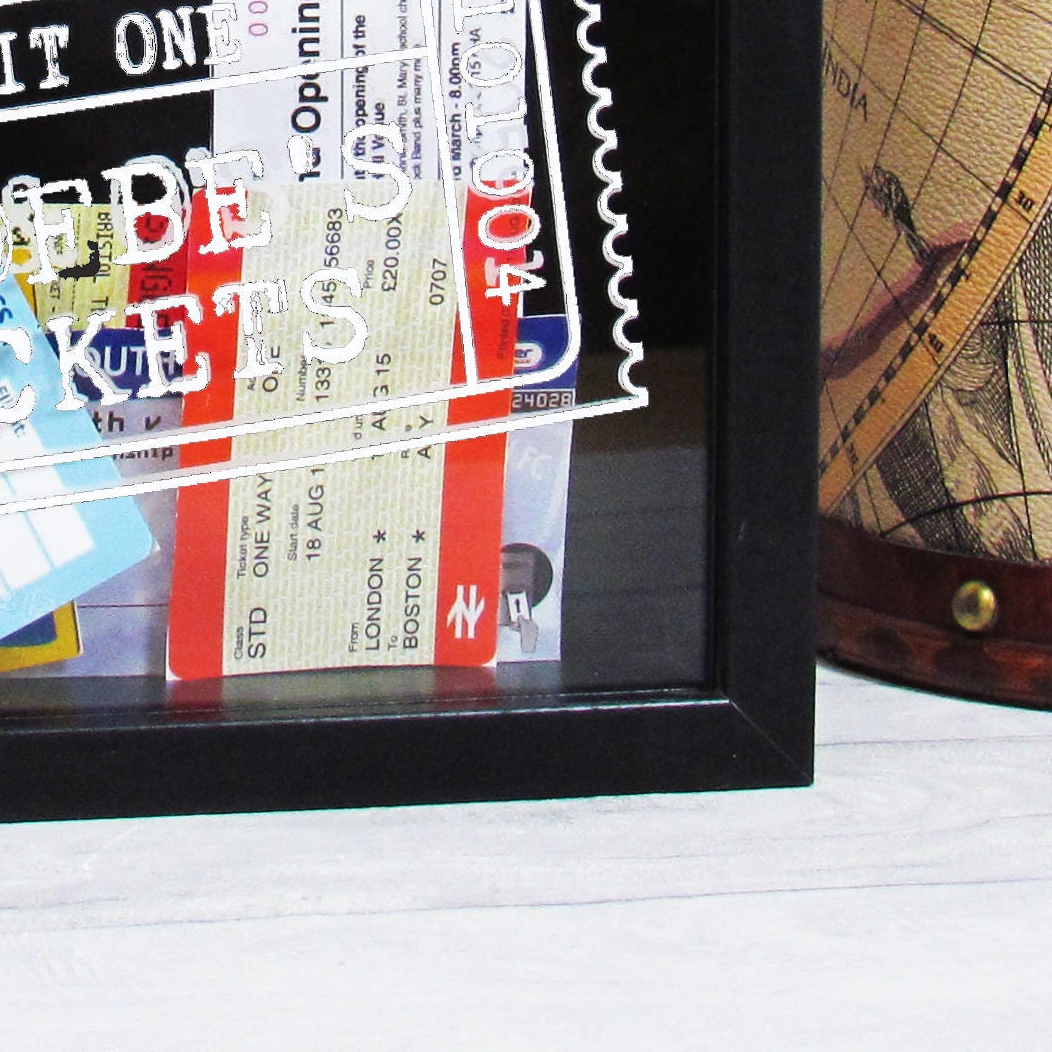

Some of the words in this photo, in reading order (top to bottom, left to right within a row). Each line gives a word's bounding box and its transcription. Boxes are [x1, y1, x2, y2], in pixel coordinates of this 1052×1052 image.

[115, 2, 242, 76] ONE
[352, 14, 366, 41] the
[363, 259, 375, 289] Price
[429, 258, 448, 306] 0707
[375, 353, 392, 377] 15
[256, 473, 274, 524] WAY
[307, 484, 325, 532] AUG
[238, 515, 251, 545] type
[289, 503, 300, 529] date
[236, 546, 249, 580] Ticket
[252, 530, 271, 578] ONE
[287, 532, 298, 562] Start
[306, 537, 322, 562] 18
[364, 557, 384, 651] LONDON
[403, 556, 422, 650] BOSTON
[234, 626, 245, 661] Class
[247, 606, 268, 659] STD
[348, 621, 359, 653] From
[387, 634, 398, 651] To
